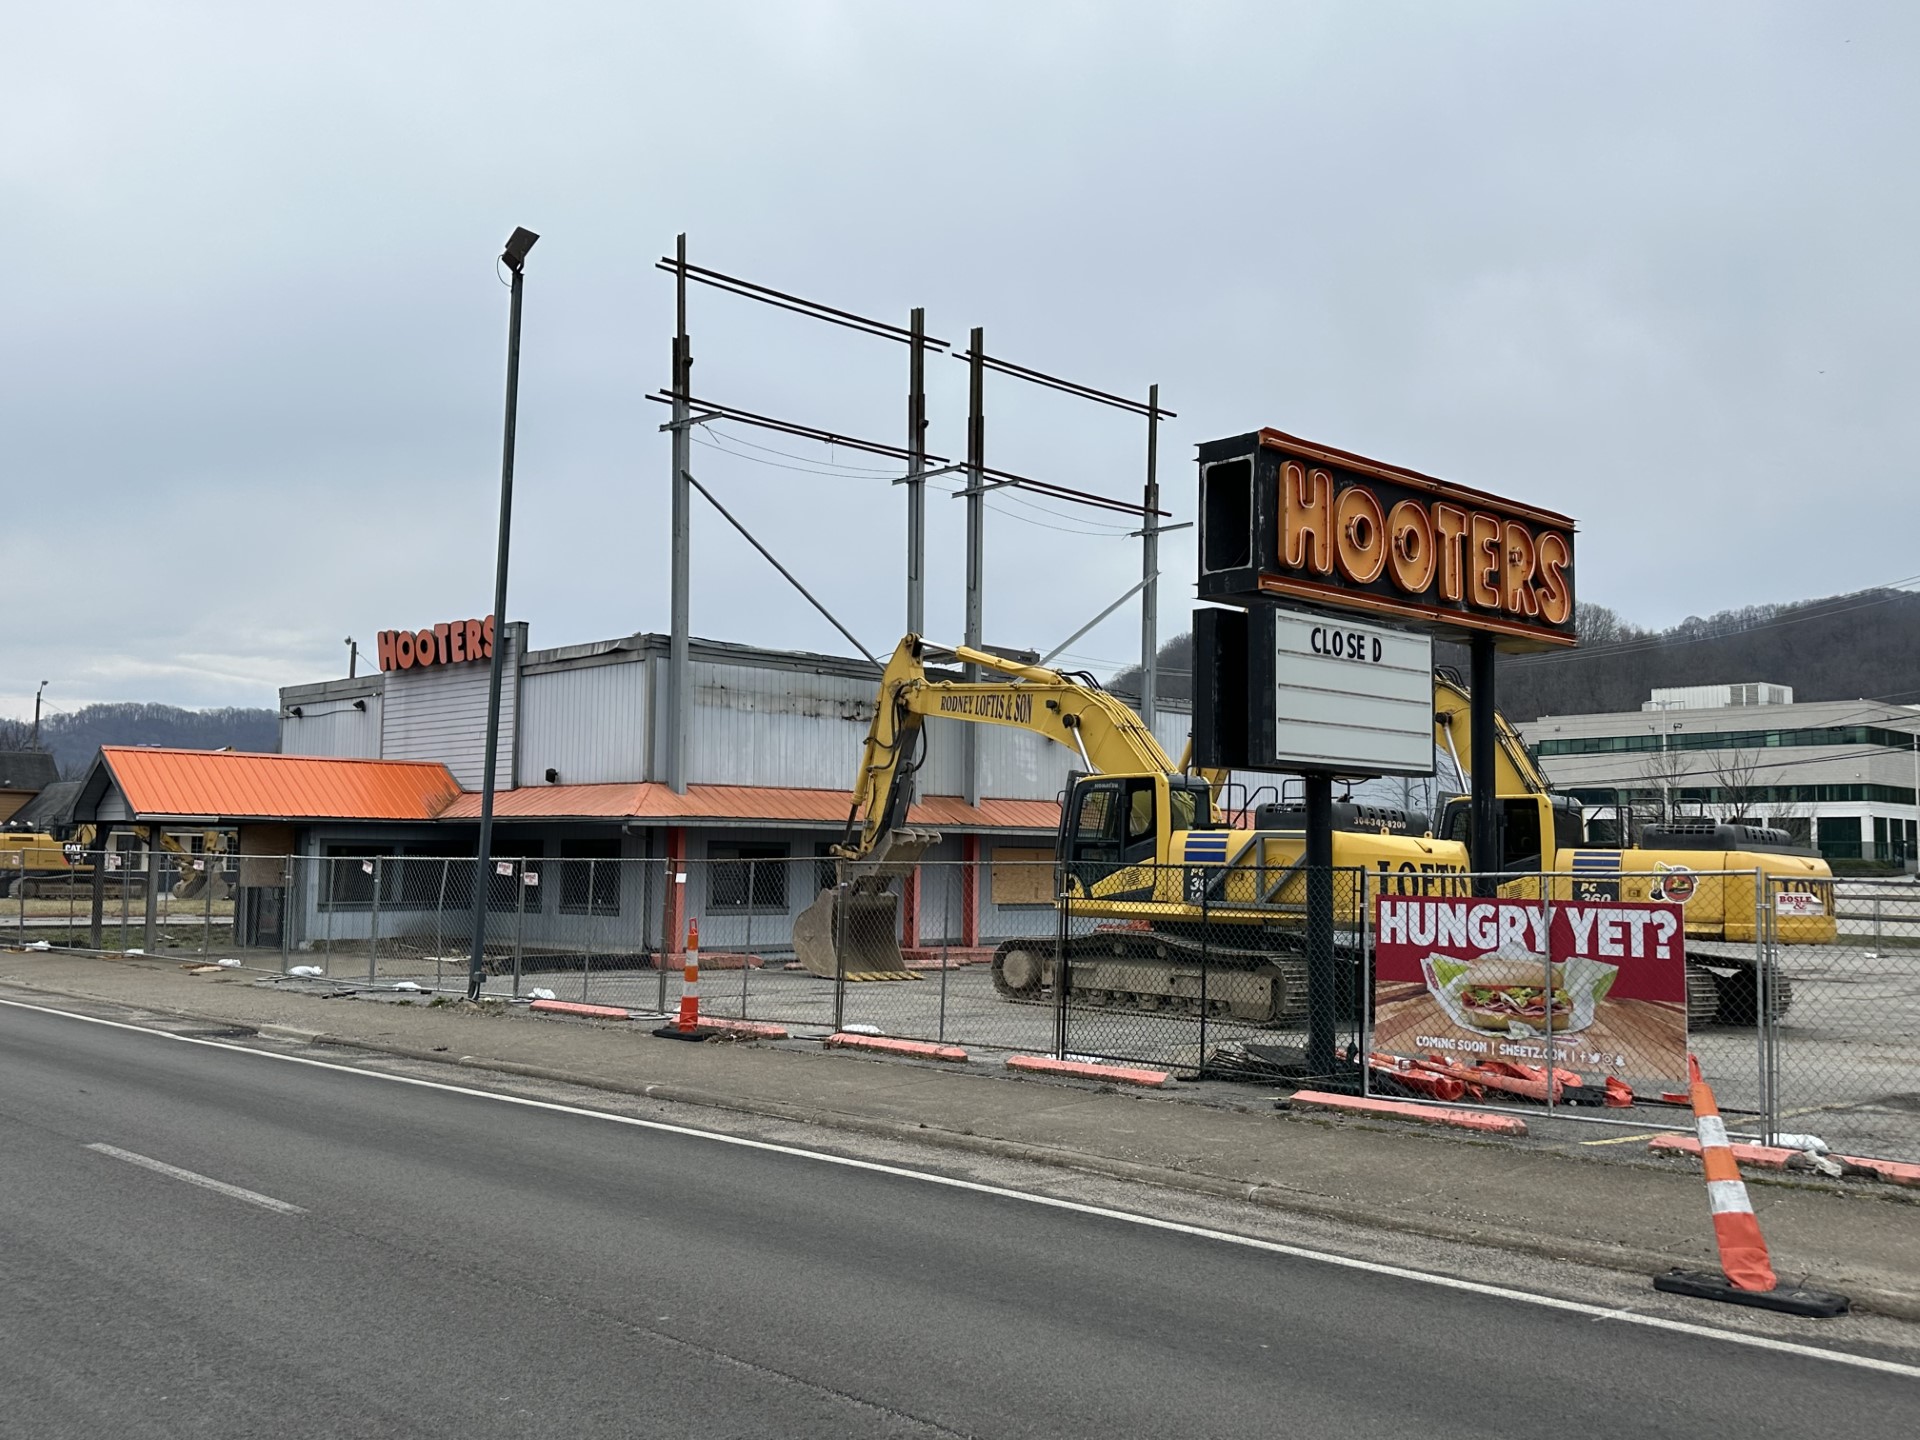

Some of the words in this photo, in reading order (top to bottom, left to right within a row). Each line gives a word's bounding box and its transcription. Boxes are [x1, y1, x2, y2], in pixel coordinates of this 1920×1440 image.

[1278, 460, 1572, 625] HOOTERS
[377, 614, 495, 672] HOOTERS
[940, 695, 975, 715] RODNEY
[974, 693, 1005, 720] LOFTIS
[1005, 693, 1013, 721] &
[1013, 693, 1034, 725] SON
[65, 844, 82, 854] CAT
[1580, 882, 1597, 892] PC
[1380, 901, 1556, 952] HUNGRY
[1565, 907, 1678, 960] YET?
[1457, 1039, 1487, 1053] SOON
